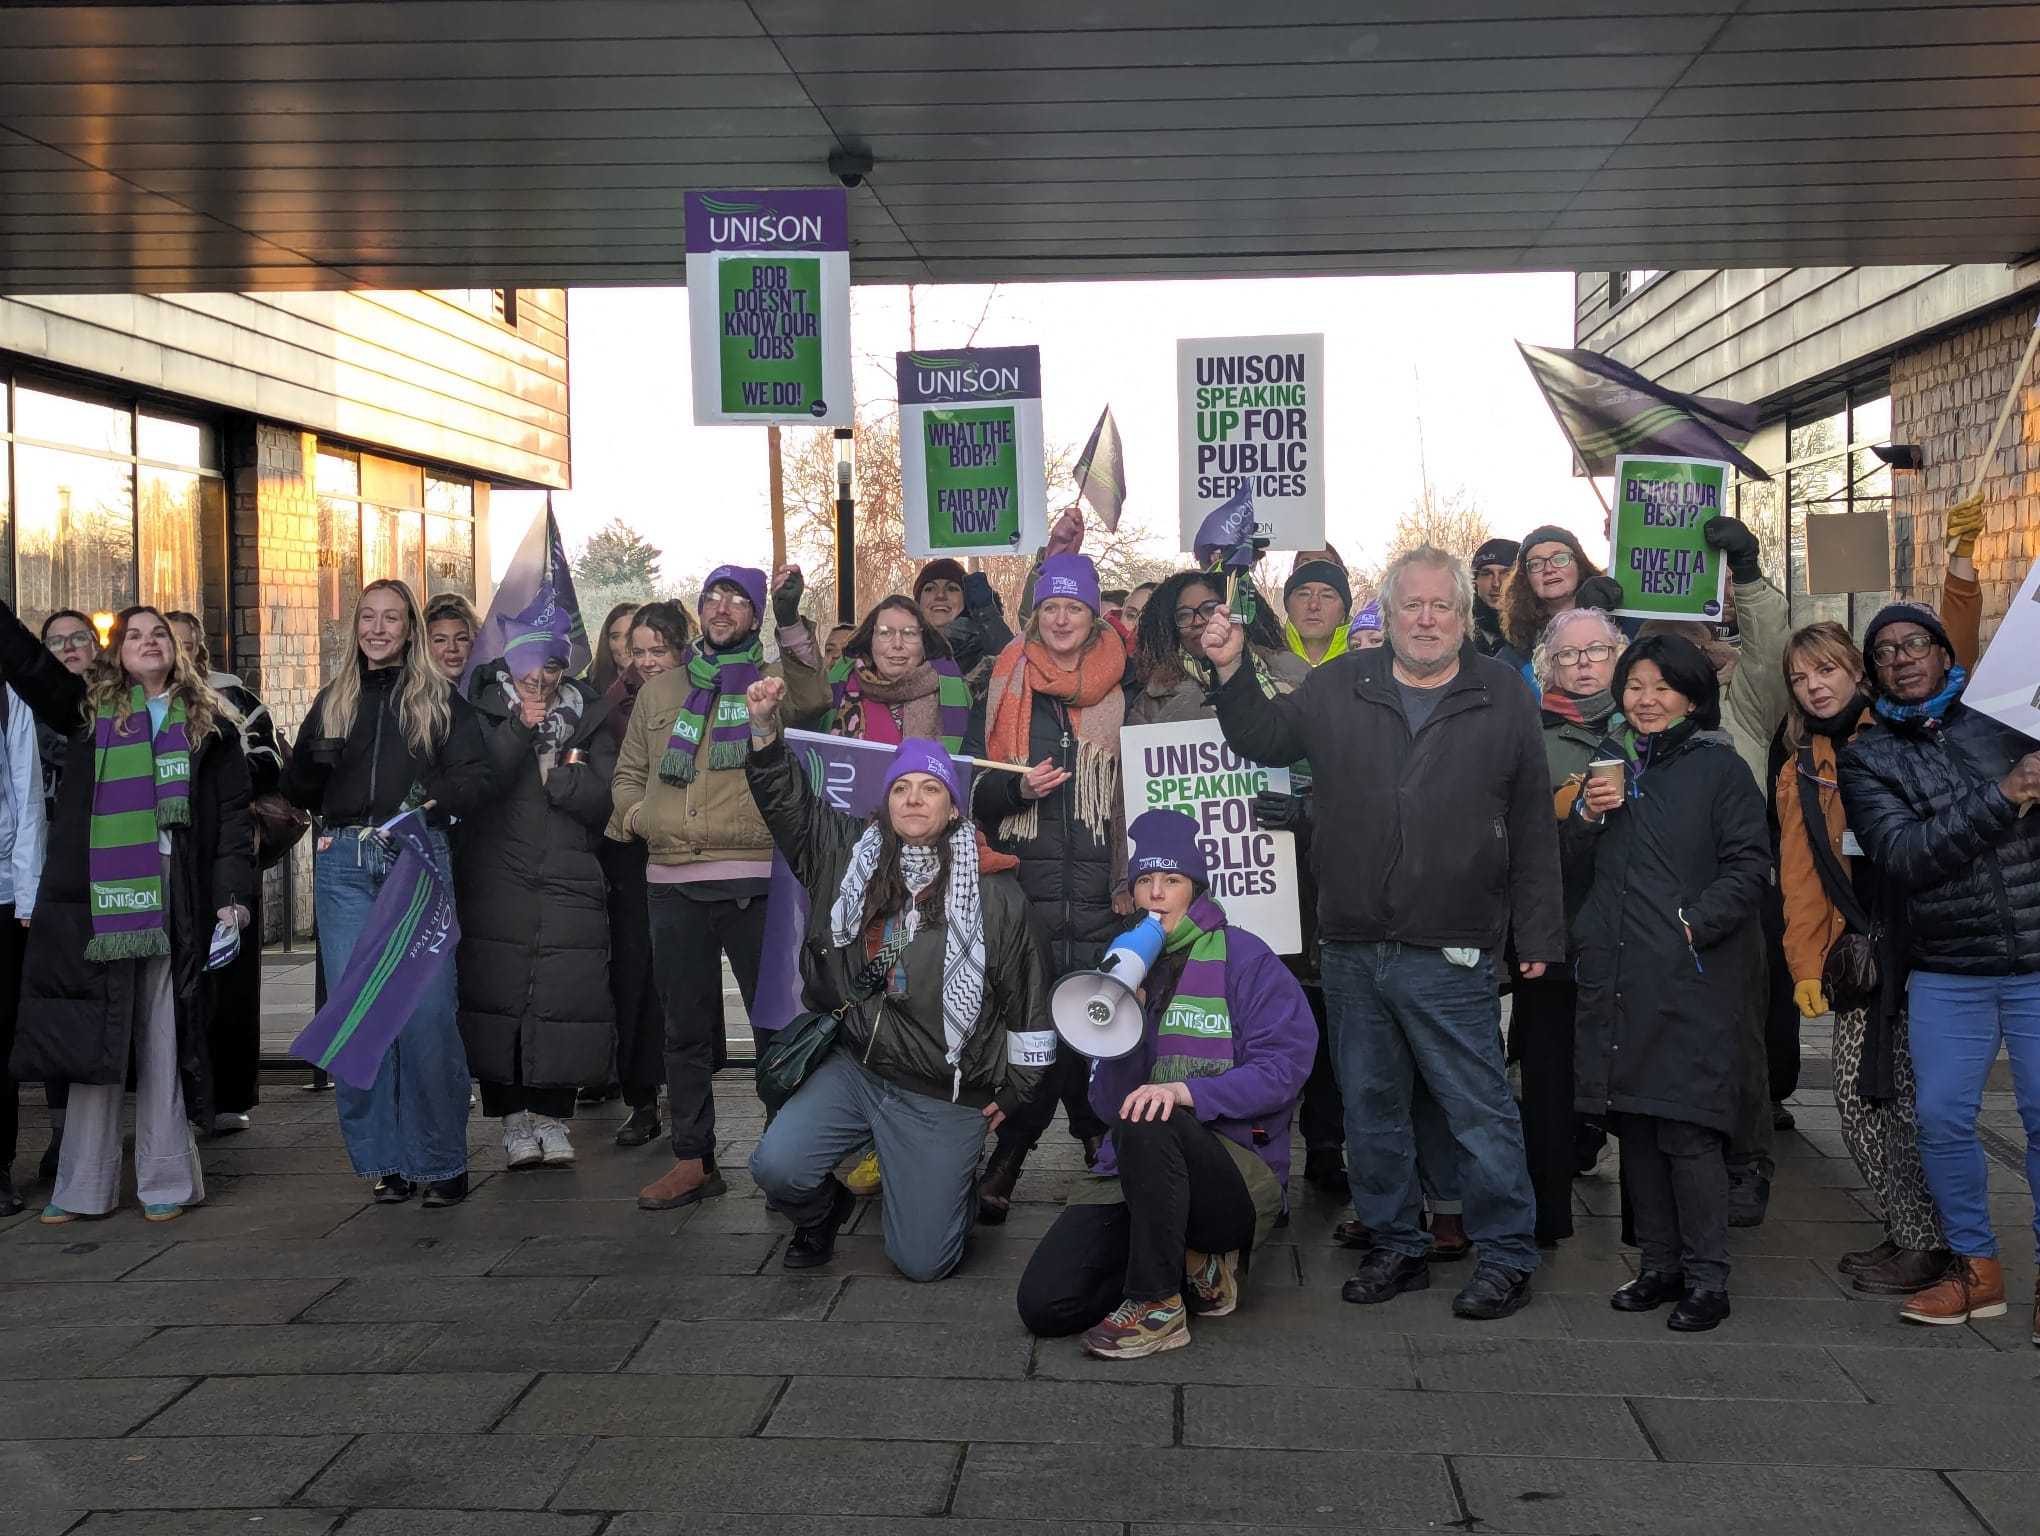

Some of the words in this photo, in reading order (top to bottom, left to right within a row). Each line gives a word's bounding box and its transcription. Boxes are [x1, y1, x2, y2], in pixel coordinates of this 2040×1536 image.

[709, 215, 822, 243] UNISON
[752, 265, 787, 290] BOB
[734, 289, 806, 313] DOESN'T
[724, 312, 777, 337] KNOW
[781, 313, 817, 340] OUR
[748, 335, 795, 360] JOBS
[917, 367, 1019, 395] UNISON
[1196, 353, 1305, 386] UNISON
[742, 382, 771, 406] WE
[773, 383, 801, 407] DO!
[1196, 384, 1306, 409] SPEAKING
[928, 423, 974, 446] WHAT
[979, 420, 1012, 444] THE
[1197, 410, 1239, 442] UP
[1244, 408, 1307, 440] FOR
[949, 444, 998, 468] BOB?!
[1198, 442, 1307, 474] PUBLIC
[937, 489, 974, 513] FAIR
[977, 486, 1009, 511] PAY
[1626, 479, 1680, 505] BEING
[1684, 482, 1717, 507] OUR
[951, 509, 997, 533] NOW!
[1643, 502, 1699, 528] BEST?
[1630, 546, 1671, 571] GIVE
[1673, 548, 1691, 573] IT
[1692, 552, 1705, 574] A
[1641, 570, 1692, 595] REST!
[1144, 742, 1258, 777] UNISO
[1146, 771, 1269, 804] SPEAKING
[1198, 834, 1276, 871] BLIC
[1208, 870, 1277, 898] VICES
[98, 890, 157, 908] UNISON
[1165, 1009, 1232, 1031] UNISON
